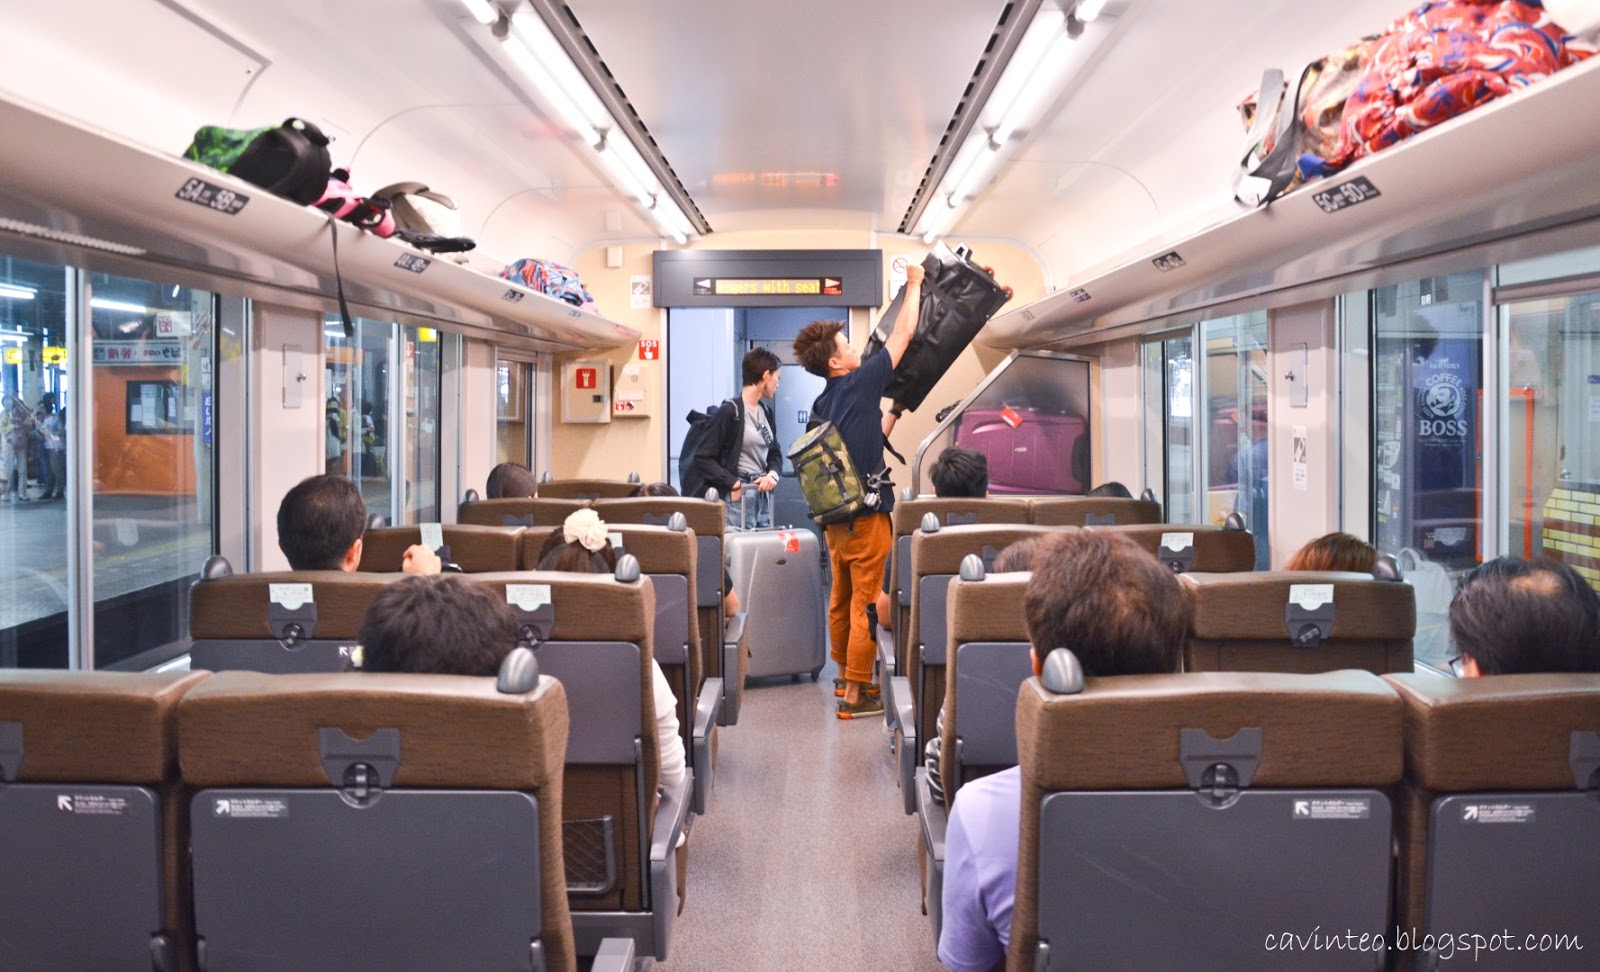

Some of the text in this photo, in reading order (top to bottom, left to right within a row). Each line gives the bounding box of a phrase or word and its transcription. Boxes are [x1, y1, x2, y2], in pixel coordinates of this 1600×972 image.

[763, 280, 790, 294] with
[640, 340, 657, 348] SOS
[1425, 372, 1463, 387] COFFEE
[1418, 420, 1468, 436] BOSS
